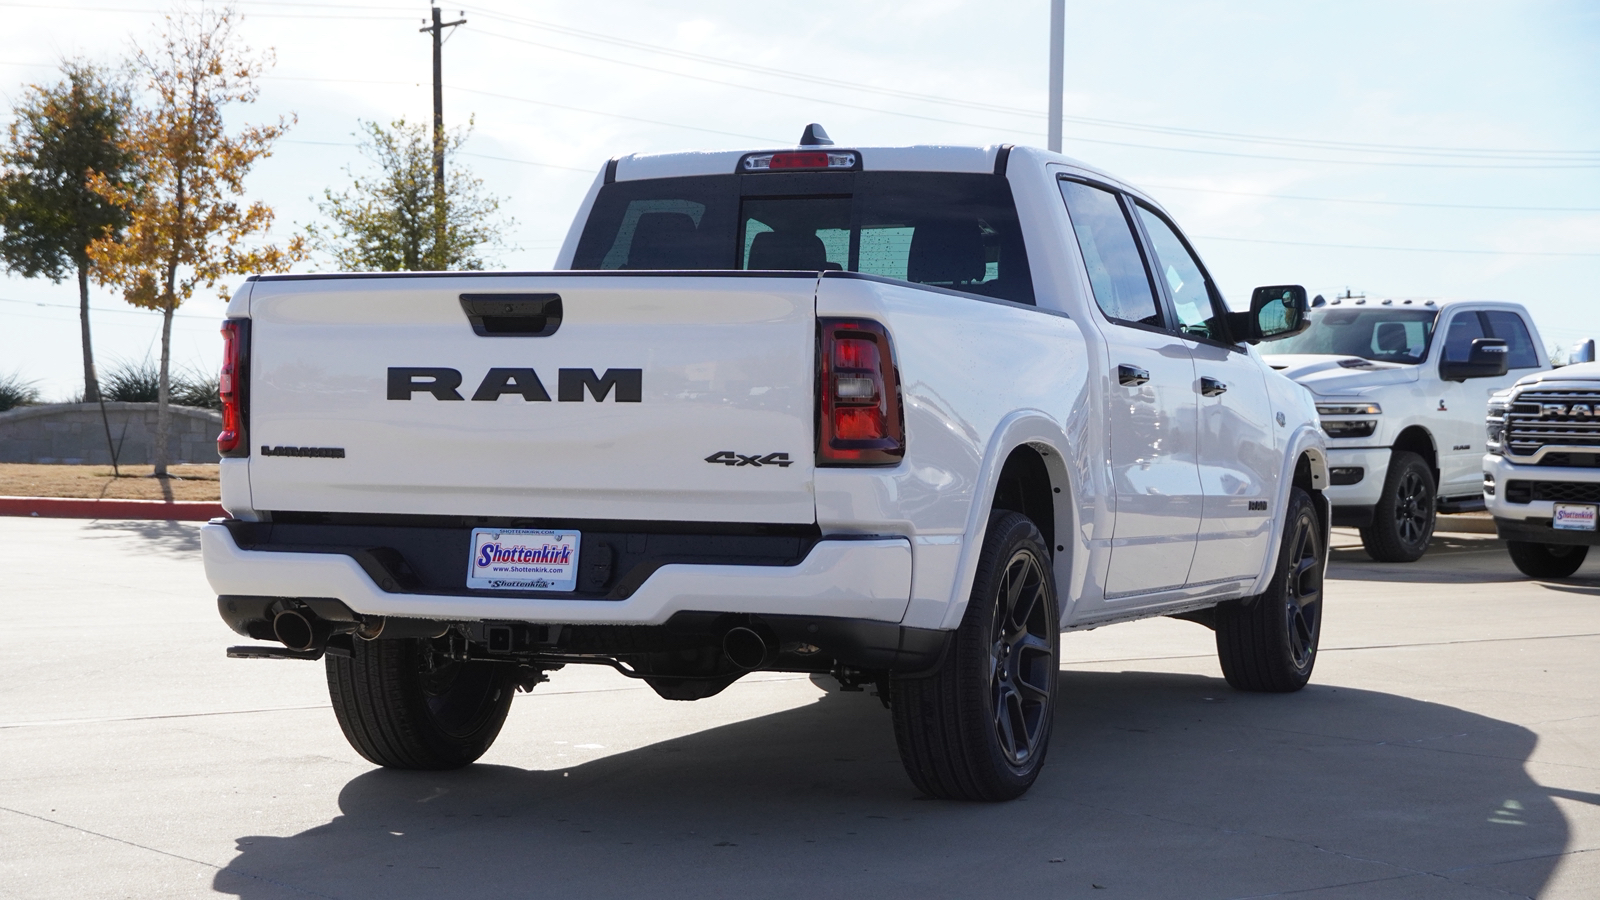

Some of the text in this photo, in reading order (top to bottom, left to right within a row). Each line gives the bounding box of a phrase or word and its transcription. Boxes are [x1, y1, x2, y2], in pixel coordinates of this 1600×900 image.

[387, 366, 642, 402] RAM
[1543, 403, 1600, 416] RA
[477, 543, 572, 567] Shottenkirk
[491, 580, 549, 588] Shottenkirk
